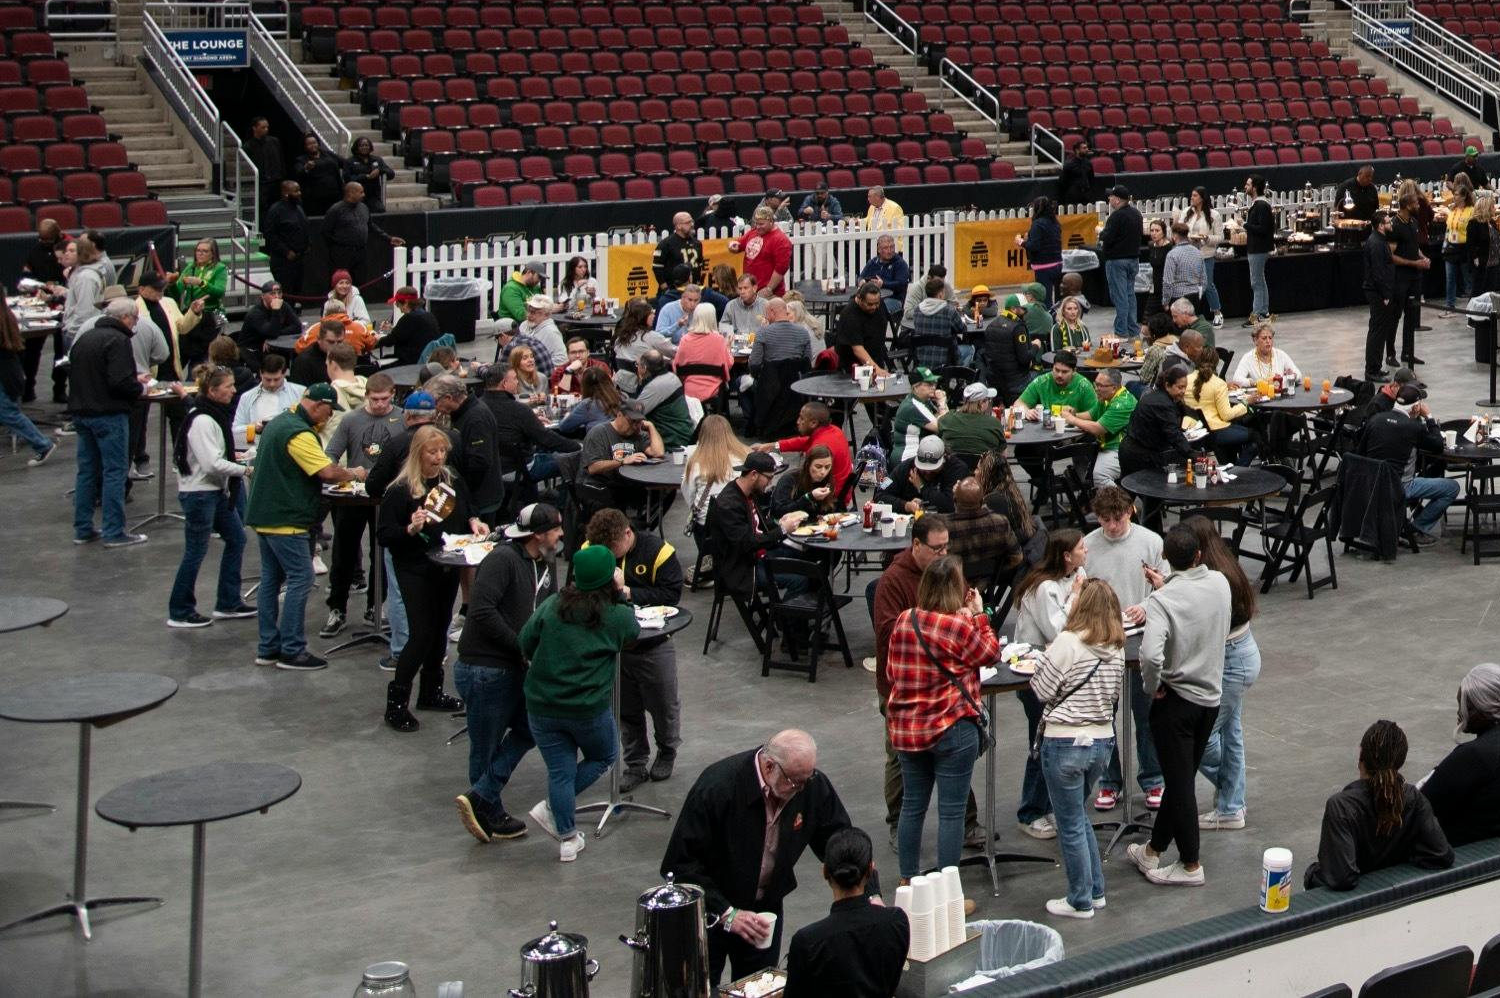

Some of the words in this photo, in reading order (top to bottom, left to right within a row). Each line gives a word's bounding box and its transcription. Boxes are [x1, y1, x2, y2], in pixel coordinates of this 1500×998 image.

[170, 40, 189, 50] HE
[192, 39, 244, 50] LOUNGE
[681, 248, 698, 267] 12
